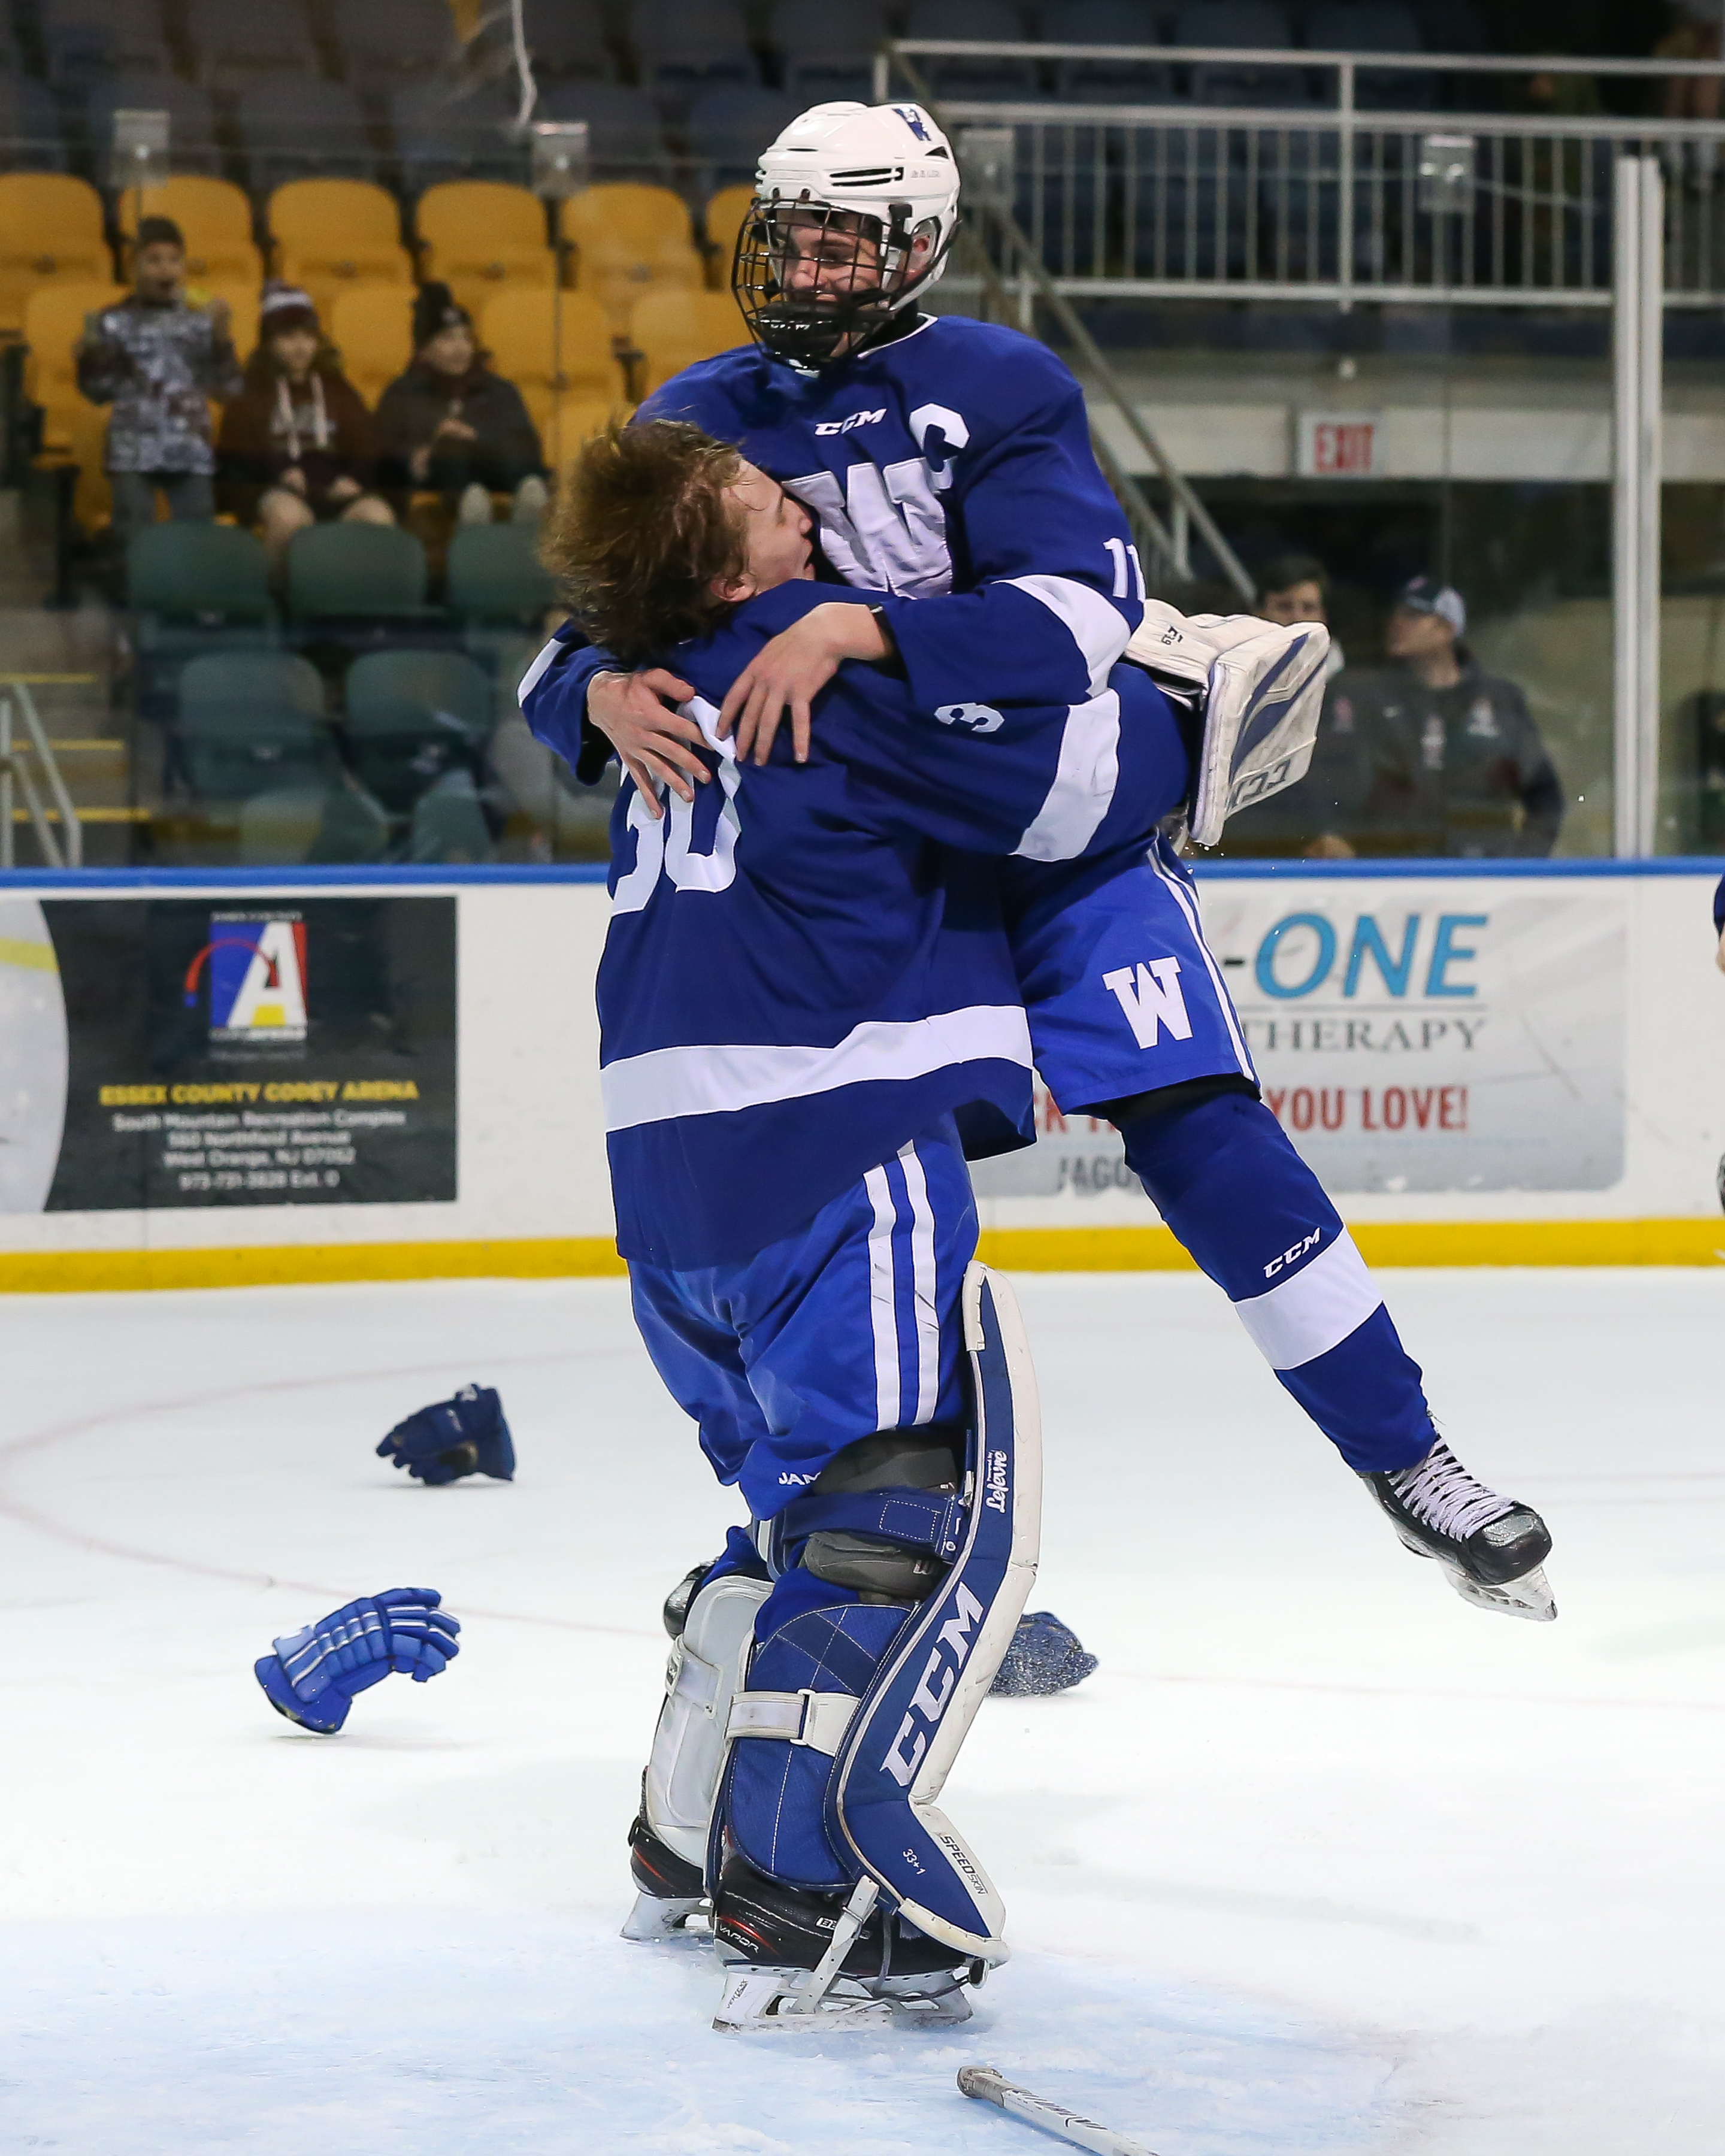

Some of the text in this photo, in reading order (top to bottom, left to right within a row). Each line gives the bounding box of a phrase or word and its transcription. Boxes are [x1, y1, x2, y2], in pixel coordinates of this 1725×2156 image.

[815, 408, 887, 436] CCM
[909, 401, 971, 495] C
[1314, 423, 1374, 472] EXIT
[1103, 537, 1146, 604] 11
[1101, 955, 1193, 1049] W
[99, 1083, 168, 1106] ESSEX
[171, 1082, 261, 1104] COUNTY
[342, 1080, 419, 1101] ARENA
[1266, 1085, 1469, 1131] YOU LOVE!
[1263, 1227, 1321, 1278] CCM
[986, 1450, 1009, 1513] Lefevre
[879, 1581, 984, 1787] CCM
[903, 1848, 926, 1875] 33+1
[720, 1924, 759, 1954] VAPOR
